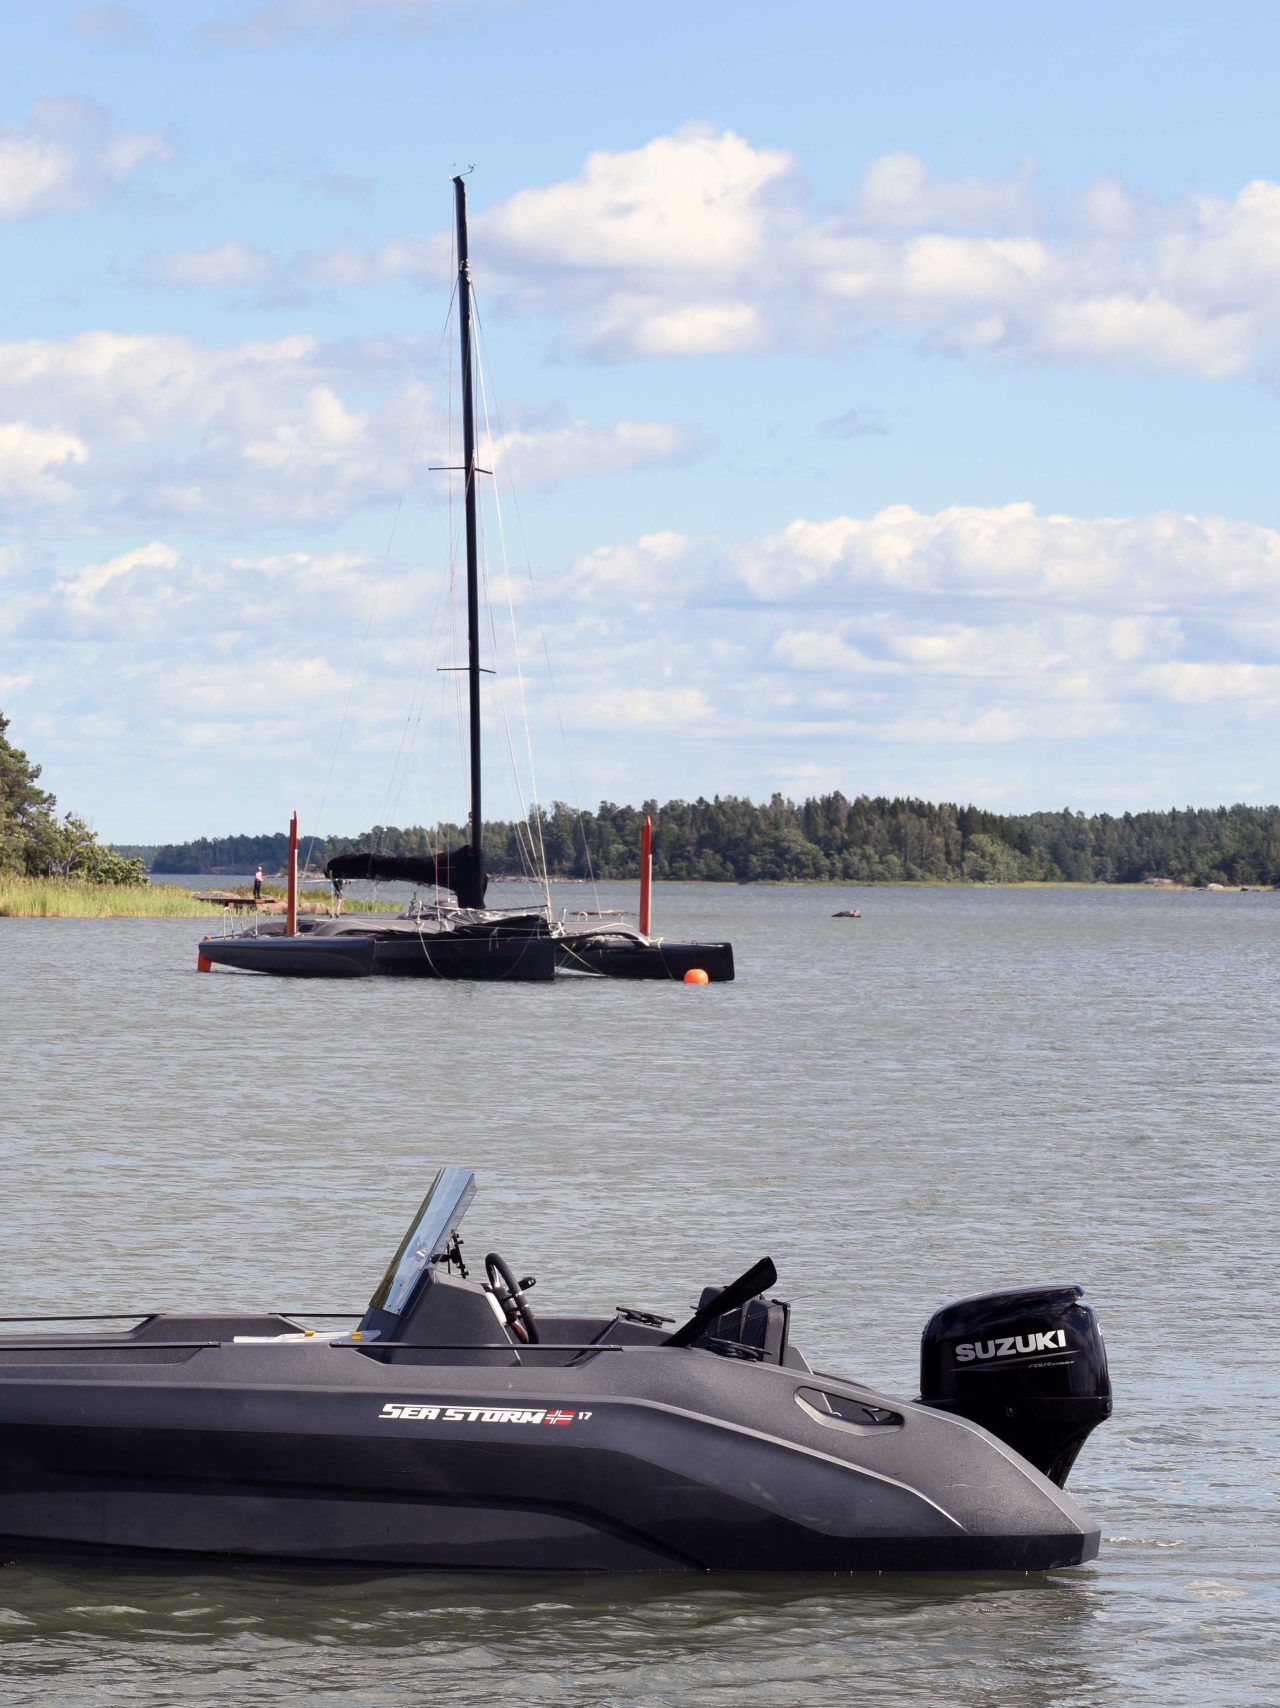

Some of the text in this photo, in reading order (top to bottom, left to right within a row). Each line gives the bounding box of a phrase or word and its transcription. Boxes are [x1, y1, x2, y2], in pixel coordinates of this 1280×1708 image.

[955, 1329, 1067, 1362] SUZUKI
[378, 1403, 593, 1424] SEA STORM 17
